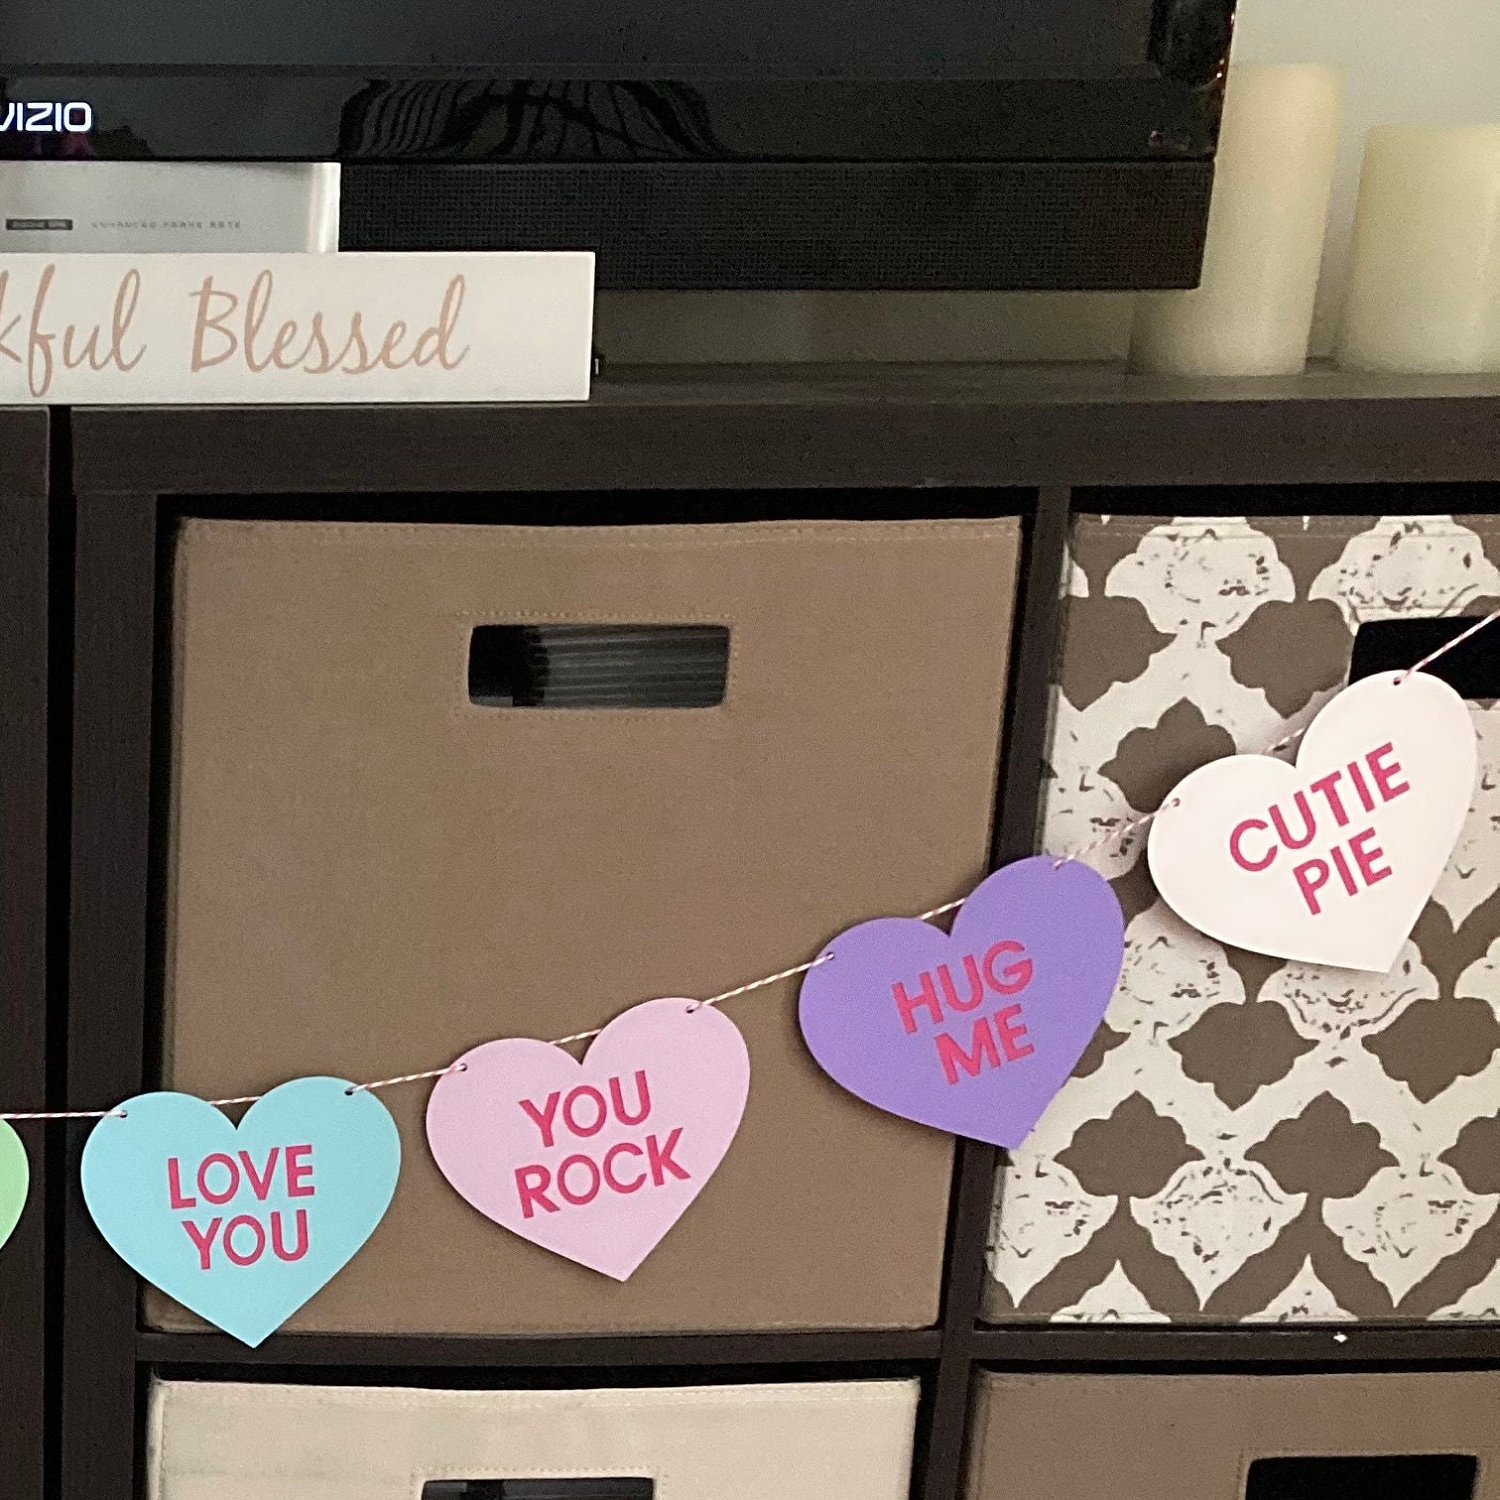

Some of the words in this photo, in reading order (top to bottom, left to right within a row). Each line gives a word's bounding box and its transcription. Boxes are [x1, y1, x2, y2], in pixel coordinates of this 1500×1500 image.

[188, 269, 471, 375] Blessed
[1229, 741, 1410, 873] CUTIE
[1292, 826, 1393, 916] PIE
[891, 940, 1034, 1035] HUG
[933, 1003, 1035, 1086] ME
[517, 1069, 652, 1148] YOU
[167, 1144, 316, 1210] LOVE
[514, 1127, 692, 1219] ROCK
[181, 1208, 309, 1271] YOU
